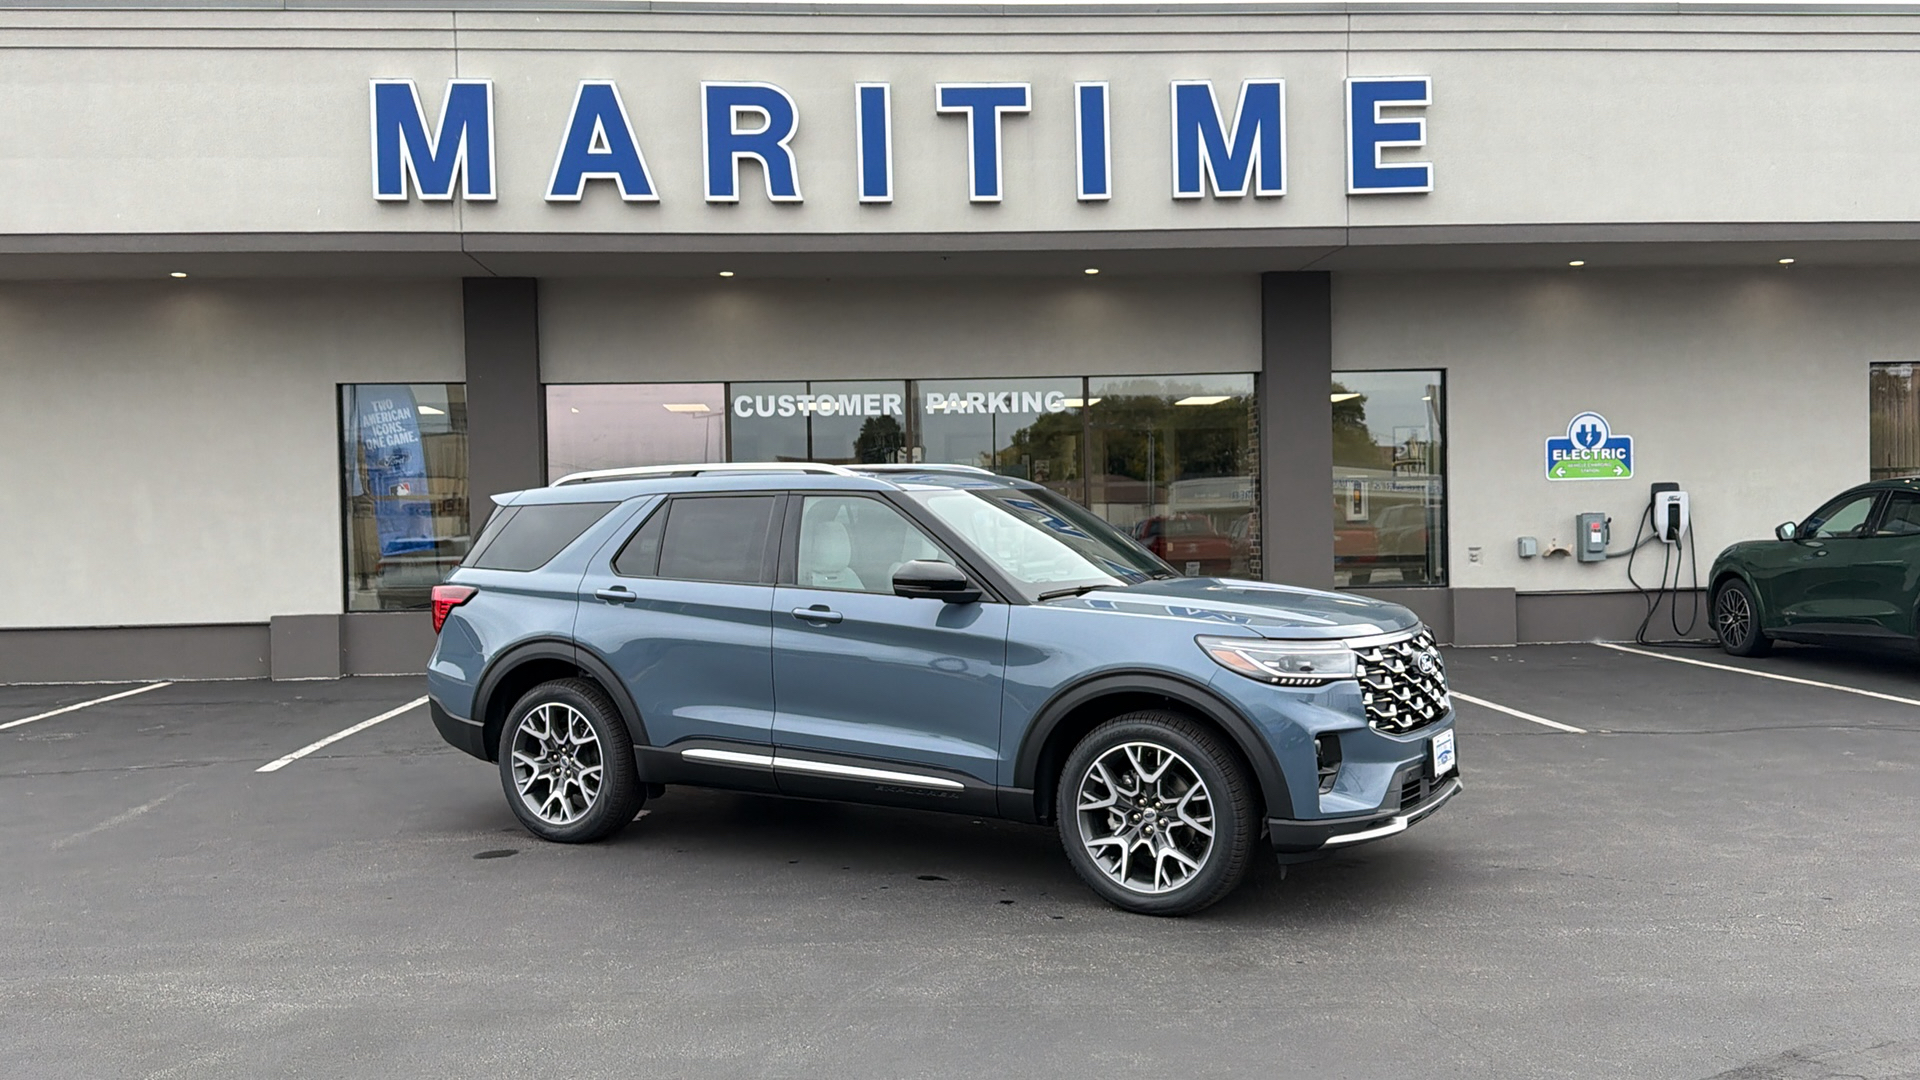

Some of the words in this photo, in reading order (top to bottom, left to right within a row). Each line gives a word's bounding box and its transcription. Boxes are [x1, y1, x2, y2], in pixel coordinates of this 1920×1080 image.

[369, 77, 1434, 203] MARITIME
[371, 398, 393, 412] TWO
[734, 394, 903, 418] CUSTOMER
[926, 390, 1066, 415] PARKING
[363, 407, 411, 427] AMERICAN
[372, 422, 406, 436] ICONS.
[366, 437, 386, 450] ONE
[387, 431, 418, 447] GAME.
[1553, 448, 1626, 460] ELECTRIC
